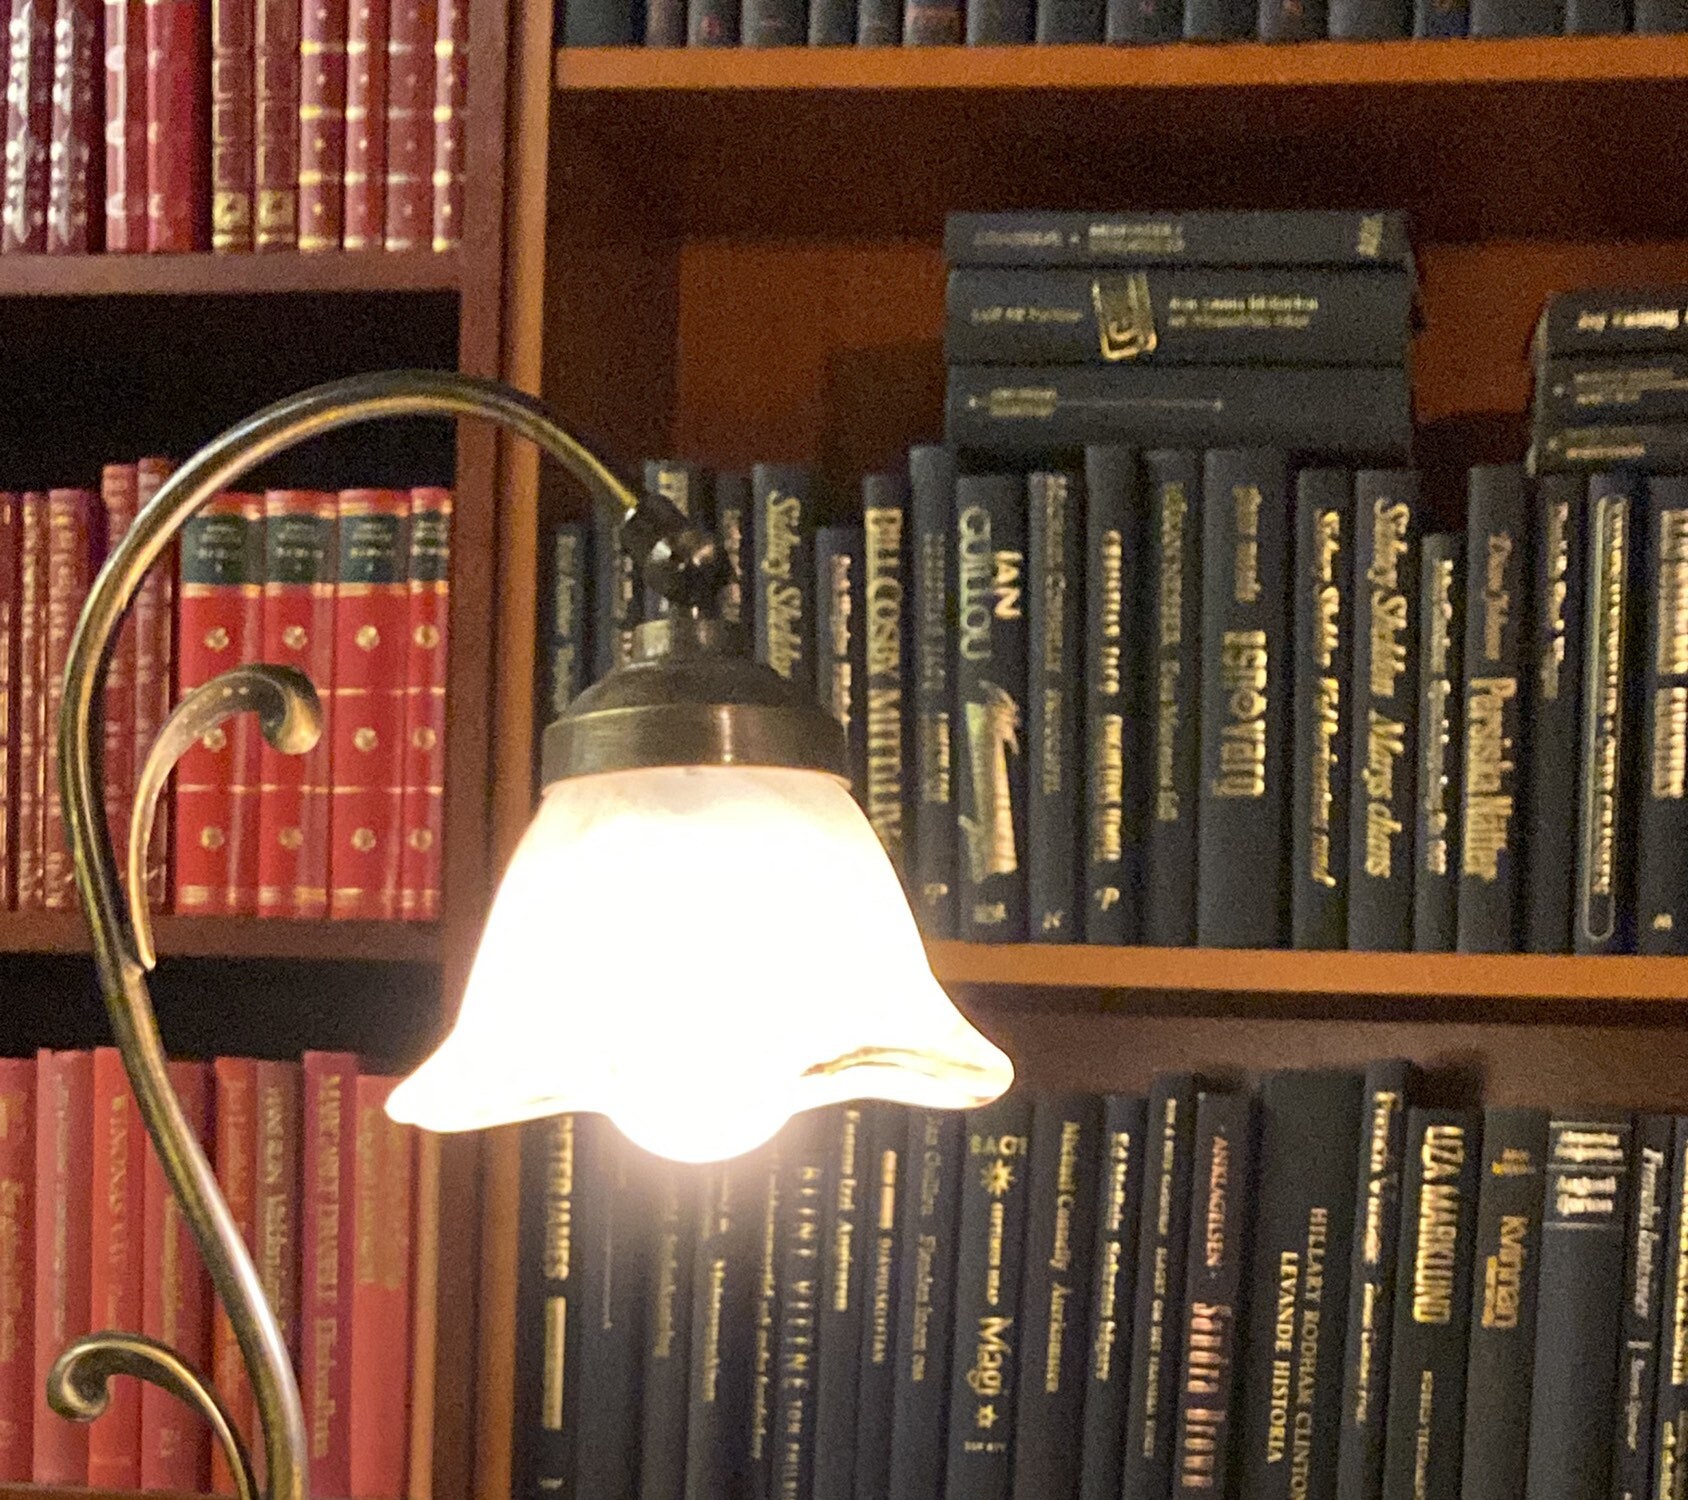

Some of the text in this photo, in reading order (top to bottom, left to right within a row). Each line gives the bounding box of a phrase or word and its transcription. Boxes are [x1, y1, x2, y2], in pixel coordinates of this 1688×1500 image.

[958, 505, 992, 661] GUILLOU
[993, 549, 1023, 620] JAN
[1367, 499, 1411, 588] Sidney
[767, 581, 803, 679] Sheldo
[866, 577, 903, 676] COSBY
[1368, 589, 1408, 698] Sheldon
[1049, 1194, 1077, 1272] Connelly
[1206, 1136, 1229, 1268] ANKLAGELSEN
[1411, 1124, 1466, 1325] LIZA MARKLUND
[1303, 1206, 1328, 1304] HILLARY
[966, 1316, 1014, 1396] Magi
[1181, 1301, 1233, 1489] Sandra Brown
[1266, 1250, 1300, 1464] LEVANDE HISTORIA
[1296, 1309, 1321, 1405] RODHAM
